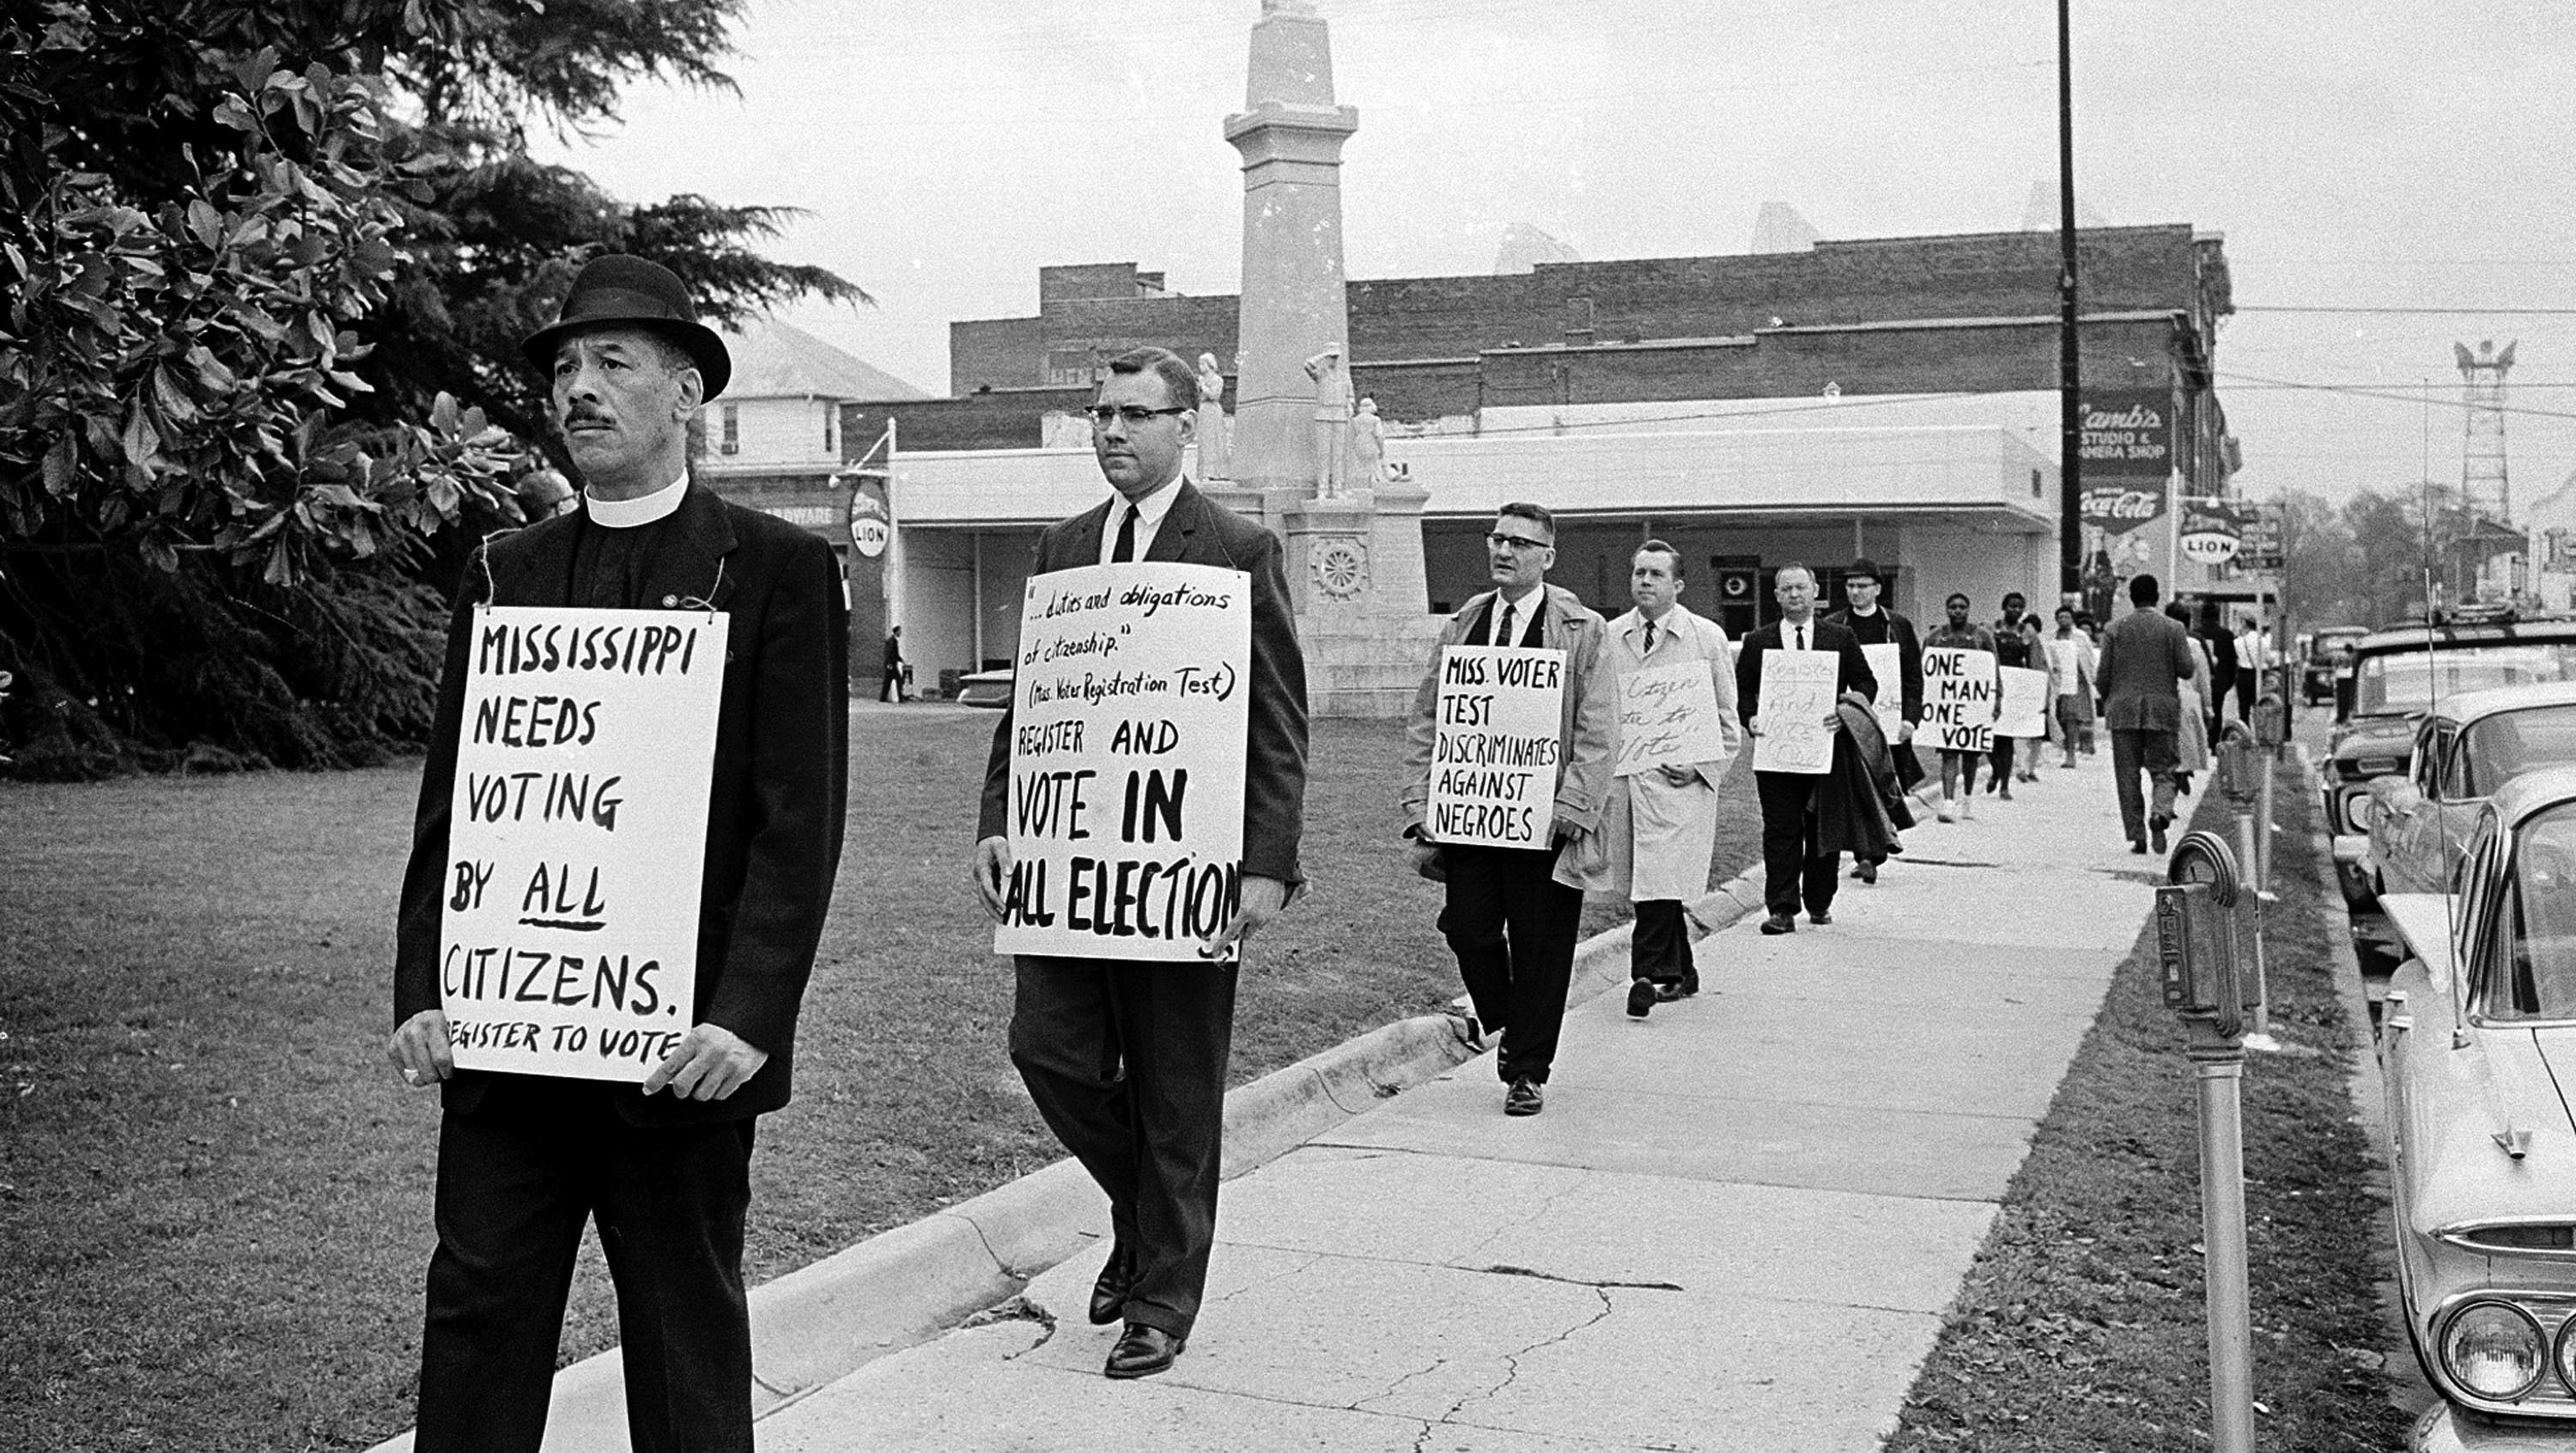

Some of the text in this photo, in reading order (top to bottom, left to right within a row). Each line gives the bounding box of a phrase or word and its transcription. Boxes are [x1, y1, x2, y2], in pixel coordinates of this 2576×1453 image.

[2081, 431, 2136, 445] STUDIO
[2127, 445, 2166, 459] SHOP
[855, 526, 884, 542] LION
[2188, 540, 2232, 553] LION
[1084, 587, 1111, 610] and
[1120, 583, 1230, 617] obligations
[479, 623, 697, 676] MISSISSIPPI
[1024, 639, 1042, 666] of
[1924, 654, 1965, 677] ONE
[1056, 677, 1081, 701] Voter
[1083, 671, 1168, 707] Registration
[1175, 661, 1236, 702] Test)
[1445, 656, 1560, 689] MISS. VOTER
[473, 696, 601, 748] NEEDS
[1443, 694, 1494, 726] TEST
[1923, 702, 1966, 726] ONE
[1018, 719, 1179, 757] REGISTER AND
[1437, 732, 1559, 768] DISCRIMINATES
[1941, 723, 1992, 751] VOTE
[469, 772, 623, 832] VOTING
[1437, 769, 1534, 801] AGAINST
[1017, 768, 1188, 843] VOTE IN
[1435, 802, 1534, 842] NEGROES
[450, 860, 606, 917] BY ALL
[1003, 858, 1055, 928] ALL
[444, 943, 677, 1016] CITIZENS.
[447, 1020, 683, 1066] EGISTER TO VOTE
